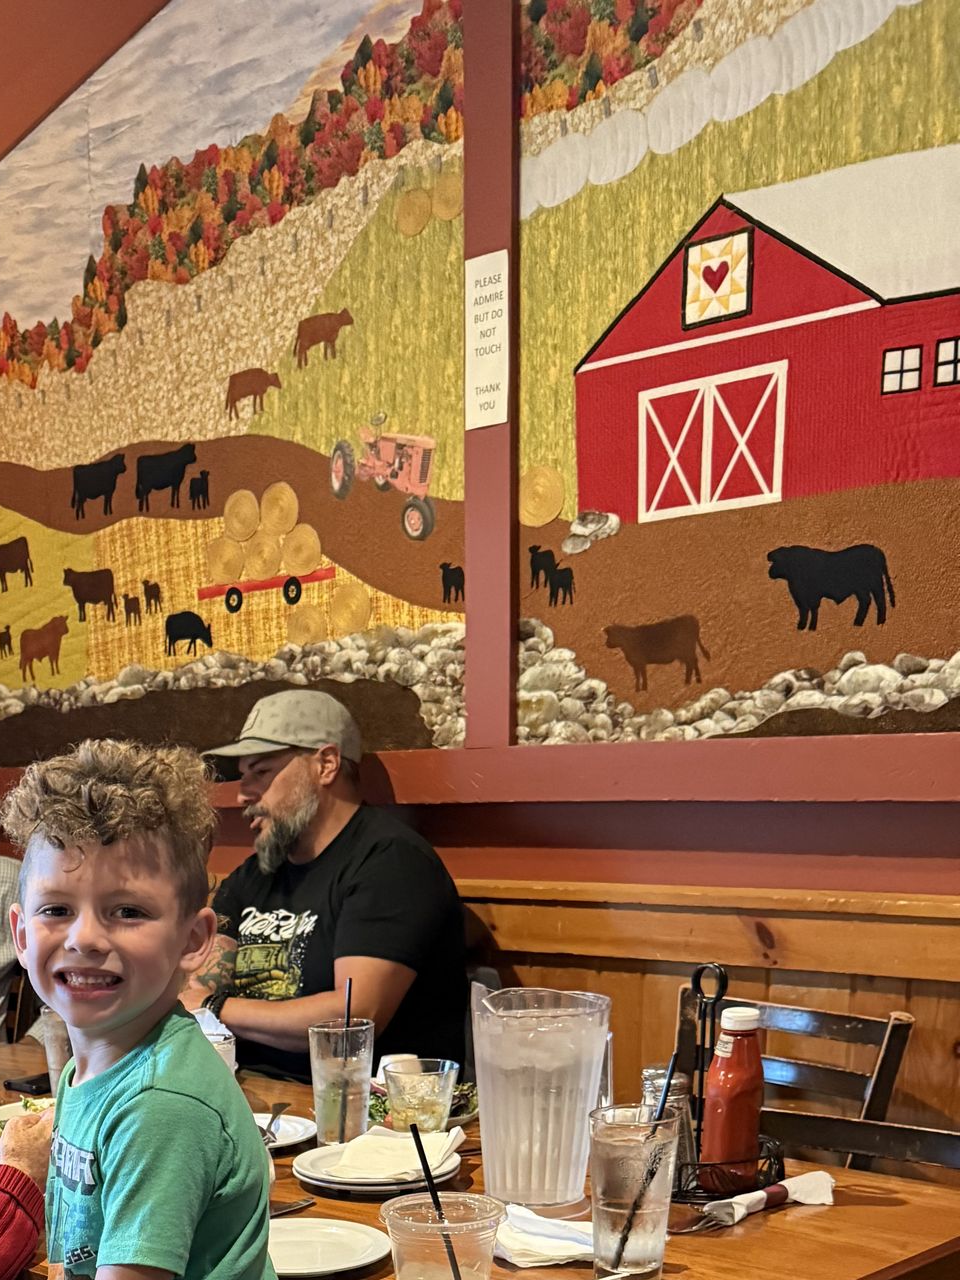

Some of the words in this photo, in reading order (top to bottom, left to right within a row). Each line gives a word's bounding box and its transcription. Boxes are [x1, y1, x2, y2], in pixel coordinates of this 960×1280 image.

[474, 273, 502, 288] PLEASE
[473, 290, 504, 307] ADMIRE
[474, 311, 489, 324] BUT
[491, 308, 503, 319] DO
[479, 327, 496, 340] NOT
[474, 343, 501, 358] TOUCH
[475, 382, 501, 396] THANK
[478, 401, 495, 412] YOU
